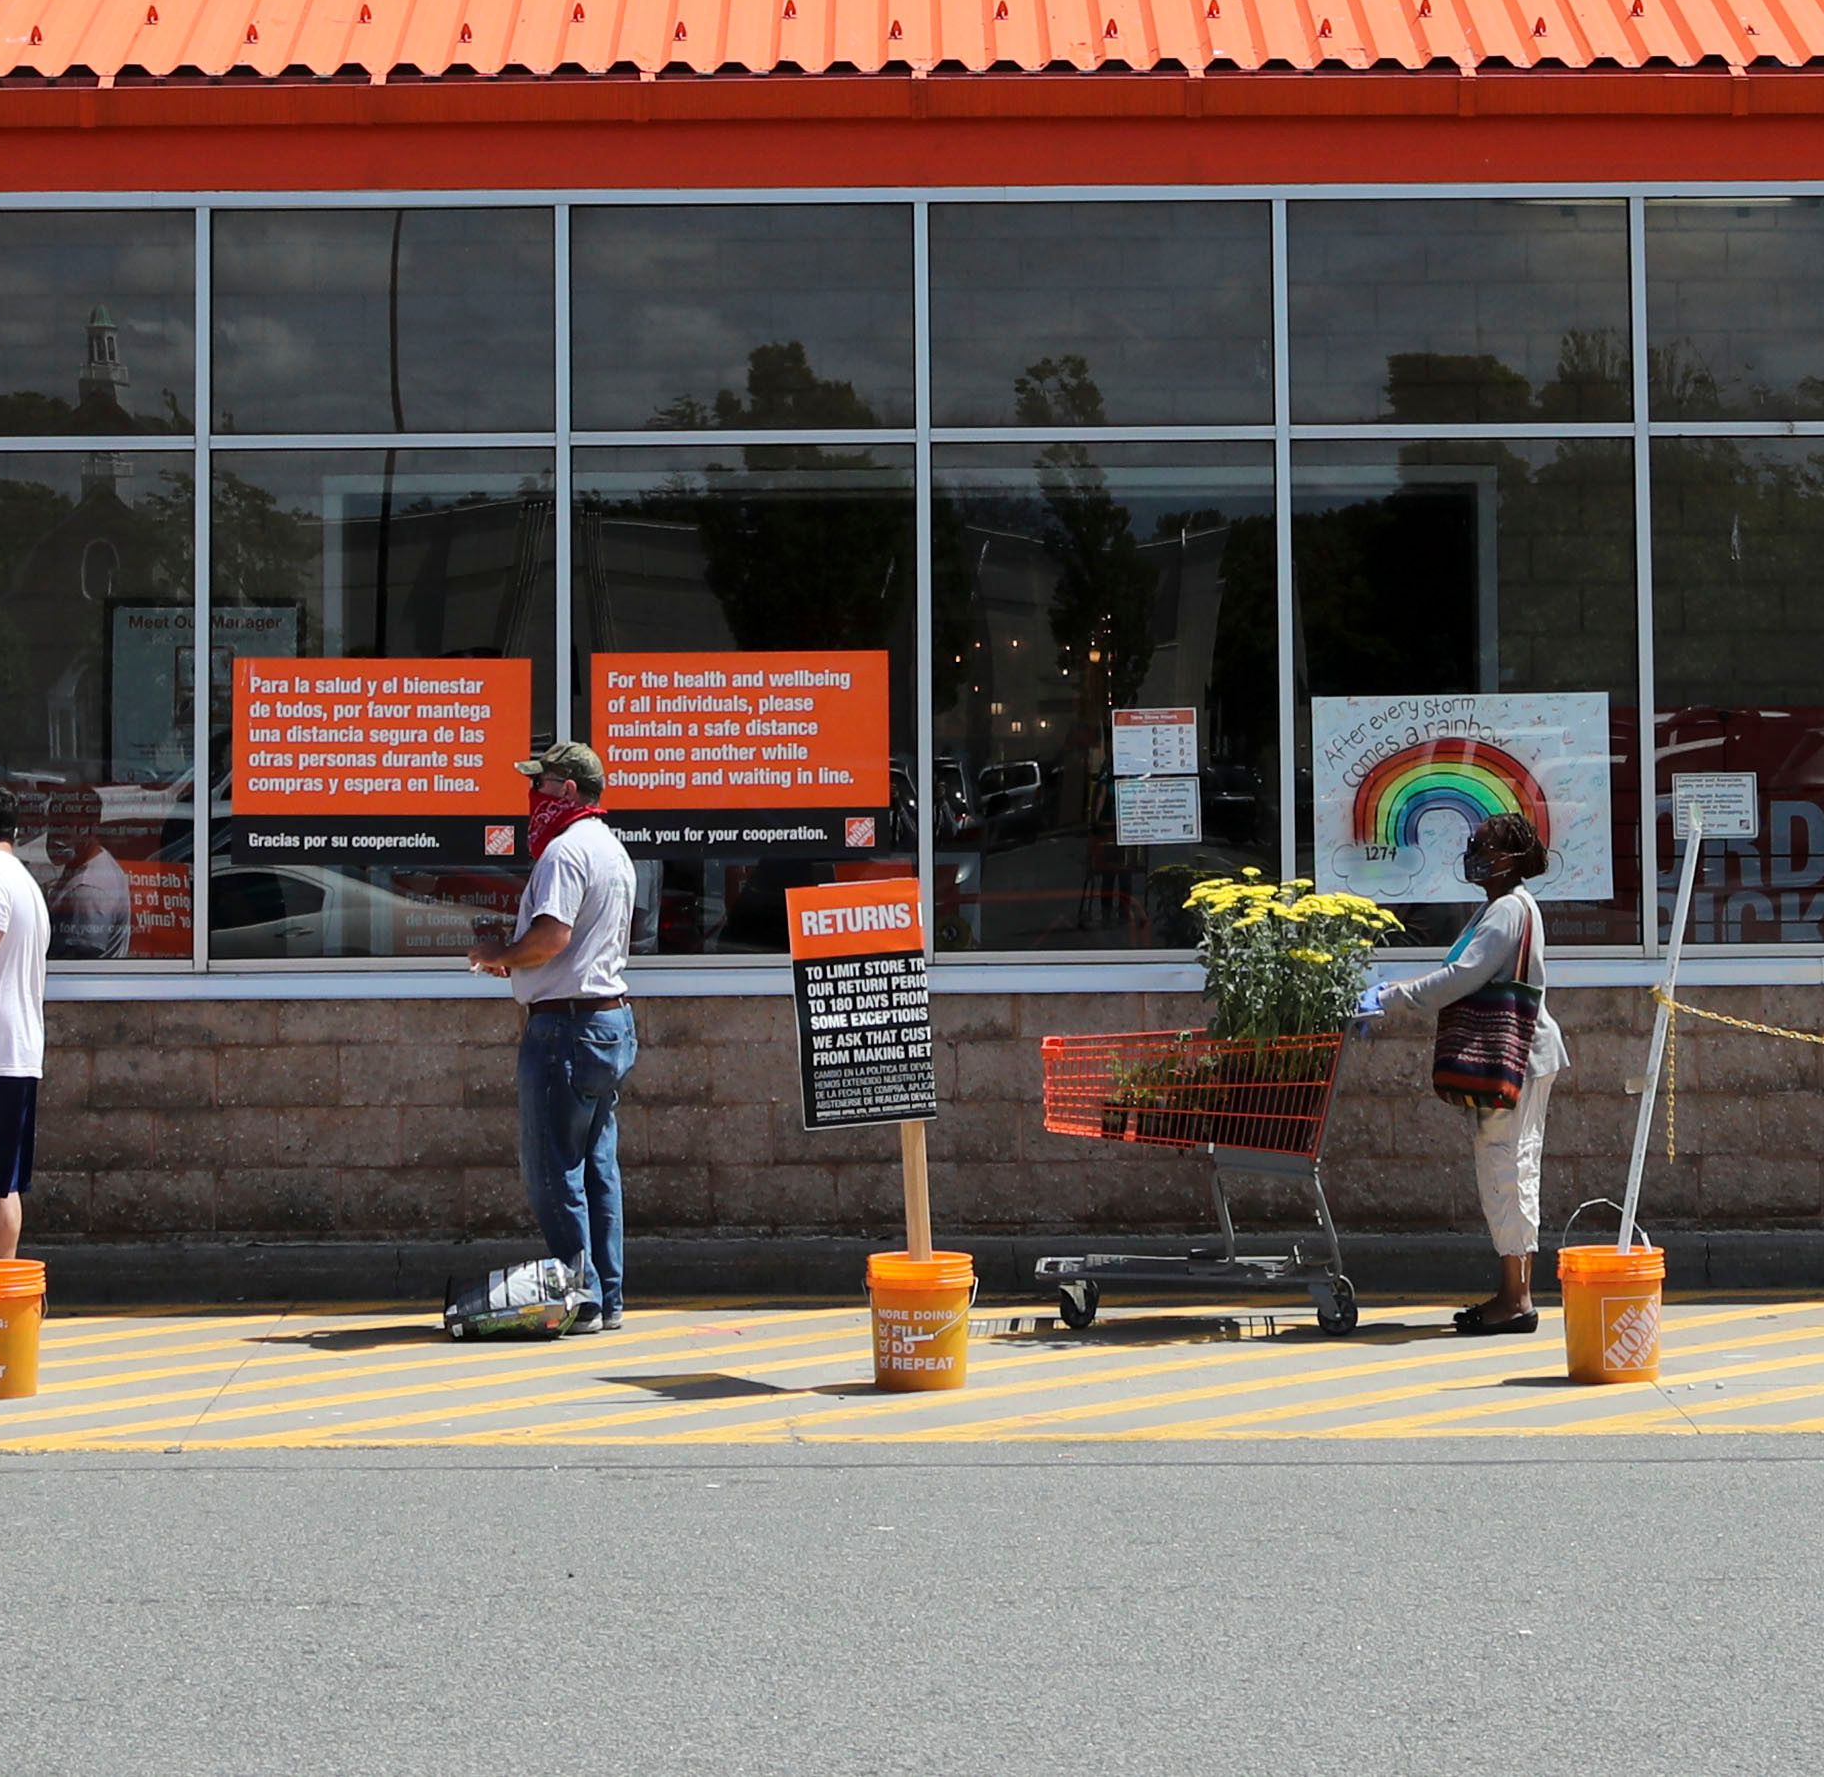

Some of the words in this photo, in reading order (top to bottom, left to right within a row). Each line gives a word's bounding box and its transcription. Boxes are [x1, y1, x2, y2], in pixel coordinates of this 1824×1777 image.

[129, 616, 168, 629] Meet
[249, 676, 288, 694] Para
[295, 676, 309, 693] la
[315, 676, 361, 693] salud
[367, 680, 377, 697] y
[382, 676, 397, 693] el
[403, 677, 483, 694] bienestar
[608, 672, 636, 689] For
[641, 671, 668, 688] the
[674, 671, 726, 688] health
[732, 670, 763, 687] and
[768, 670, 851, 690] wellbeing
[249, 701, 271, 718] de
[276, 701, 328, 721] todos,
[333, 705, 362, 722] por
[367, 701, 411, 718] favor
[416, 702, 490, 722] mantega
[608, 696, 625, 712] of
[630, 695, 650, 712] all
[656, 695, 753, 715] individuals,
[758, 695, 813, 715] please
[249, 728, 280, 743] una
[286, 726, 364, 743] distancia
[369, 729, 427, 747] segura
[433, 726, 454, 742] de
[459, 726, 485, 743] las
[608, 720, 682, 737] maintain
[688, 724, 698, 736] a
[704, 720, 740, 736] safe
[745, 720, 818, 736] distance
[1324, 723, 1368, 770] After
[1369, 699, 1419, 730] every
[248, 751, 293, 767] otras
[298, 753, 376, 770] personas
[381, 750, 448, 767] durante
[453, 753, 483, 767] sus
[607, 744, 648, 761] from
[654, 747, 685, 761] one
[691, 744, 756, 761] another
[762, 743, 808, 760] while
[1342, 735, 1401, 788] comes
[1405, 726, 1419, 746] a
[1424, 714, 1514, 747] rainbow
[248, 777, 323, 794] compras
[329, 778, 338, 794] y
[344, 777, 401, 794] espera
[407, 777, 428, 792] en
[607, 770, 686, 789] shopping
[691, 769, 723, 786] and
[728, 768, 792, 788] waiting
[797, 768, 812, 784] in
[818, 767, 854, 784] line.
[248, 832, 300, 848] Gracias
[304, 835, 327, 850] por
[331, 835, 348, 848] su
[352, 832, 440, 849] cooperación.
[655, 830, 680, 844] you
[684, 827, 703, 841] for
[708, 829, 739, 844] your
[743, 827, 827, 843] cooperation.
[1364, 846, 1397, 862] 1274
[801, 903, 912, 936] RETURNS
[805, 966, 822, 981] TO
[826, 963, 861, 979] LIMIT
[864, 959, 906, 976] STORE
[807, 982, 834, 997] OUR
[838, 977, 887, 994] RETURN
[808, 999, 825, 1014] TO
[830, 997, 853, 1012] 180
[857, 994, 889, 1010] DAYS
[892, 990, 928, 1007] FROM
[810, 1014, 848, 1030] SOME
[850, 1007, 928, 1027] EXCEPTIONS
[812, 1035, 833, 1050] WE
[836, 1032, 862, 1048] ASK
[866, 1029, 898, 1045] THAT
[813, 1050, 850, 1066] FROM
[853, 1046, 905, 1063] MAKING
[878, 1308, 908, 1320] MORE
[892, 1341, 915, 1354] DO
[892, 1356, 954, 1370] REPEAT
